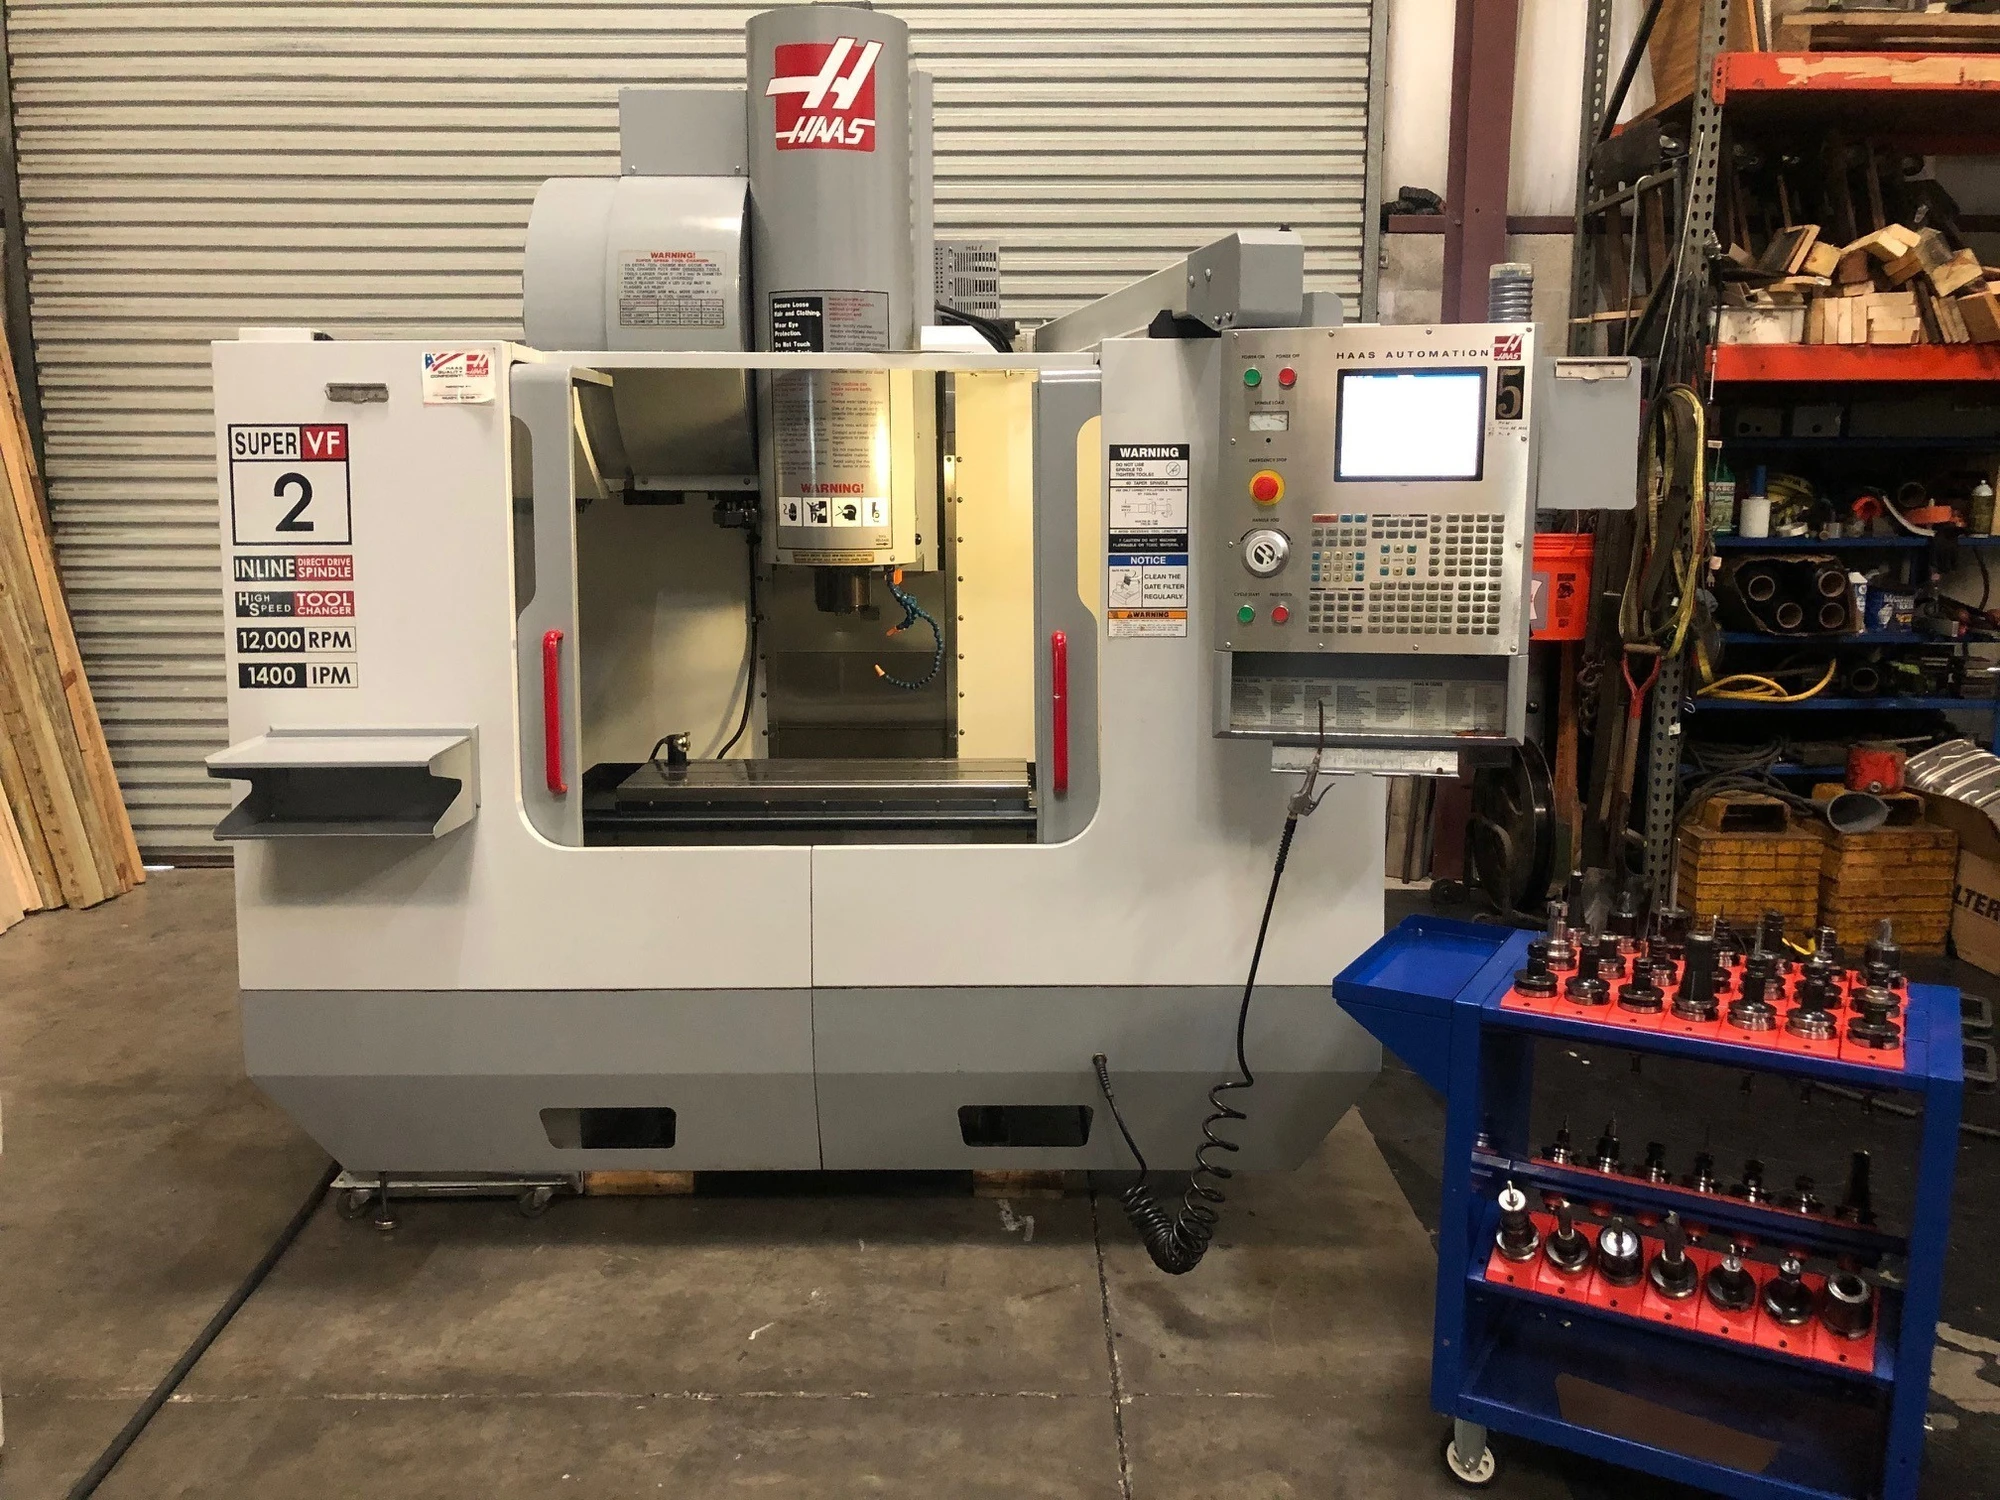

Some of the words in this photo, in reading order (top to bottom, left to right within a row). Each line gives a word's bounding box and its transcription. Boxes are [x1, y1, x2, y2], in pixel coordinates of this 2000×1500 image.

[775, 115, 876, 145] HAAS
[1386, 349, 1489, 359] AUTOMATION
[1494, 352, 1521, 360] HAAS
[1498, 368, 1521, 418] 5
[235, 432, 297, 455] SUPER
[306, 431, 340, 455] VF
[1120, 448, 1179, 458] WARNING
[801, 483, 864, 494] WARNING!
[274, 472, 314, 532] 2
[298, 558, 325, 566] DIRECT
[327, 558, 350, 566] DRIVE
[1130, 556, 1166, 564] NOTICE
[235, 558, 295, 578] INLINE
[299, 566, 351, 578] SPINDLE
[296, 592, 351, 606] TOOL
[297, 606, 352, 615] CHANGER
[240, 631, 301, 650] 12,000
[309, 631, 352, 648] RPM
[248, 666, 296, 685] 1400
[312, 666, 350, 684] IPM
